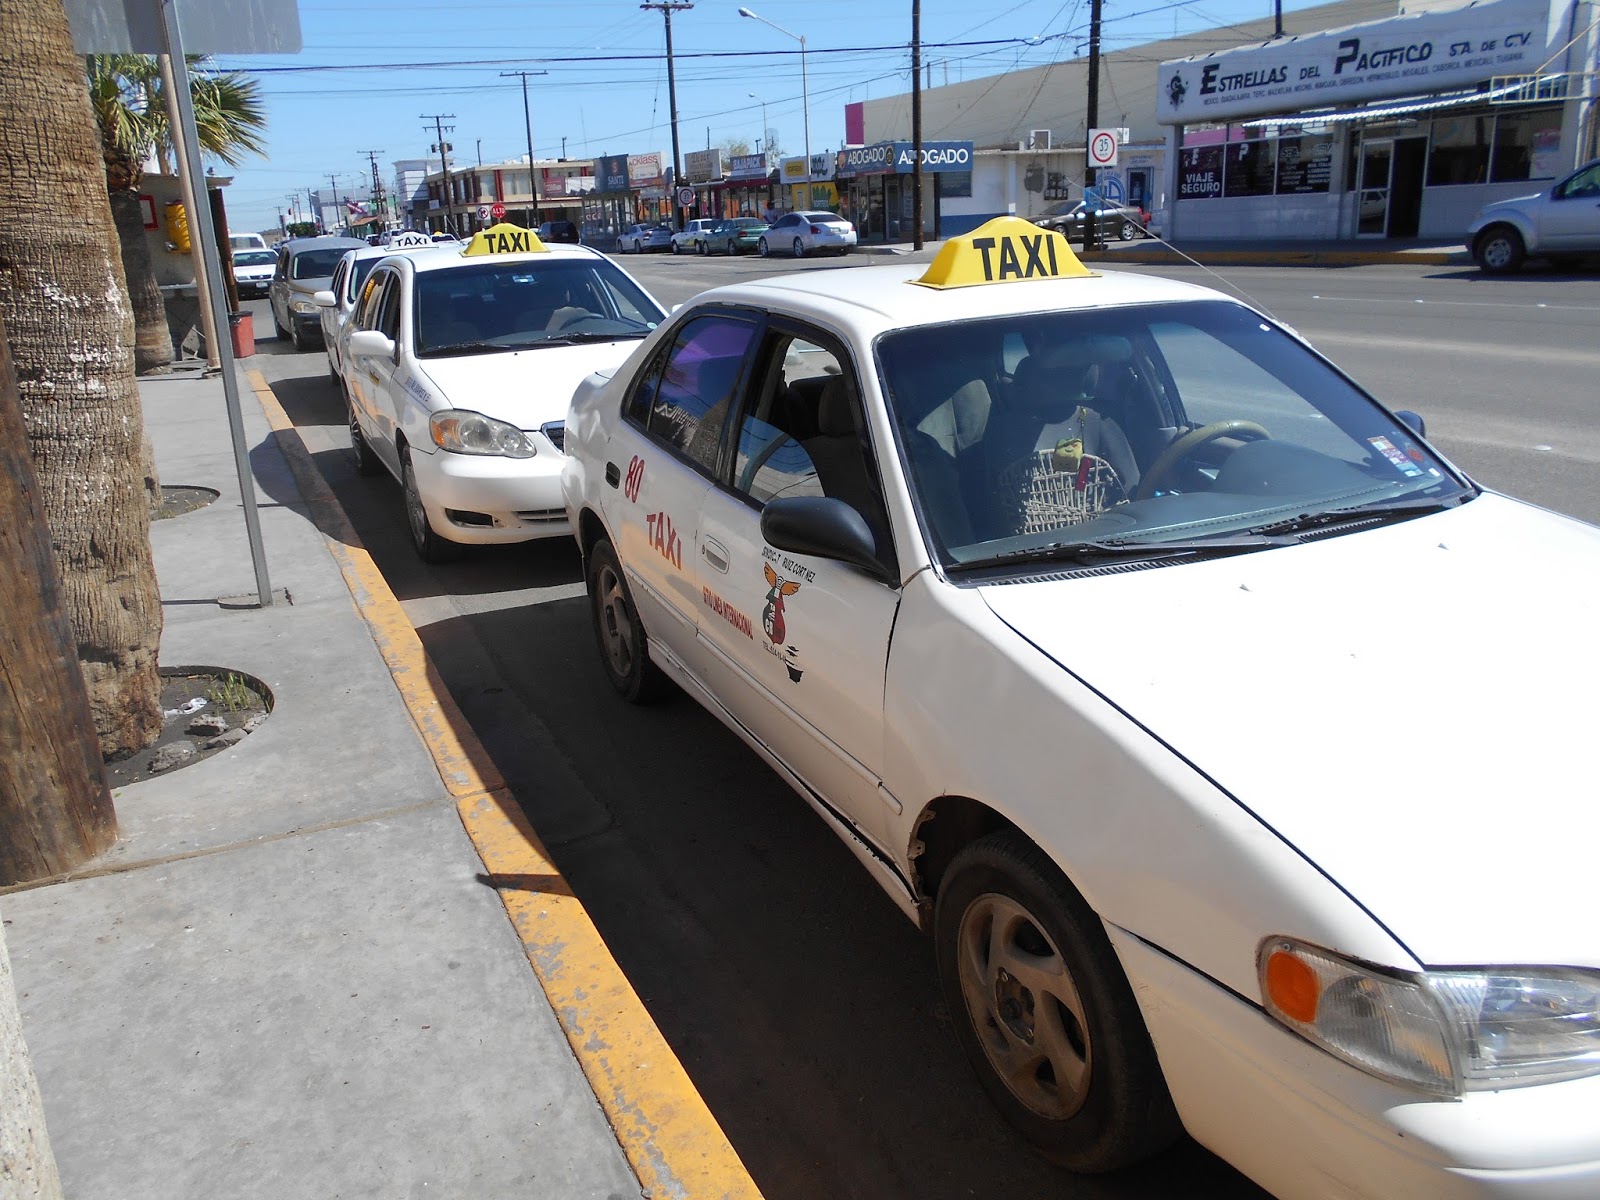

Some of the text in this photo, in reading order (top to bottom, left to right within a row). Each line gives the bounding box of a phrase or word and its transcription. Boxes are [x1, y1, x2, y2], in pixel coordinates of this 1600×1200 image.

[1200, 63, 1288, 95] ESTRELLAS
[1300, 66, 1320, 79] DEL
[1333, 37, 1433, 75] PACIFICO
[1481, 40, 1497, 51] DE
[1099, 138, 1109, 152] 35
[847, 146, 885, 165] ABOGADO
[898, 148, 969, 165] AOGADO
[1186, 172, 1214, 183] VIAJE
[1181, 181, 1221, 194] SEGURO
[492, 207, 505, 215] ALTO
[395, 236, 427, 247] TAXI
[484, 232, 531, 254] TAXI
[972, 234, 1059, 281] TAXI
[624, 454, 645, 503] 80
[646, 511, 682, 571] TAXI
